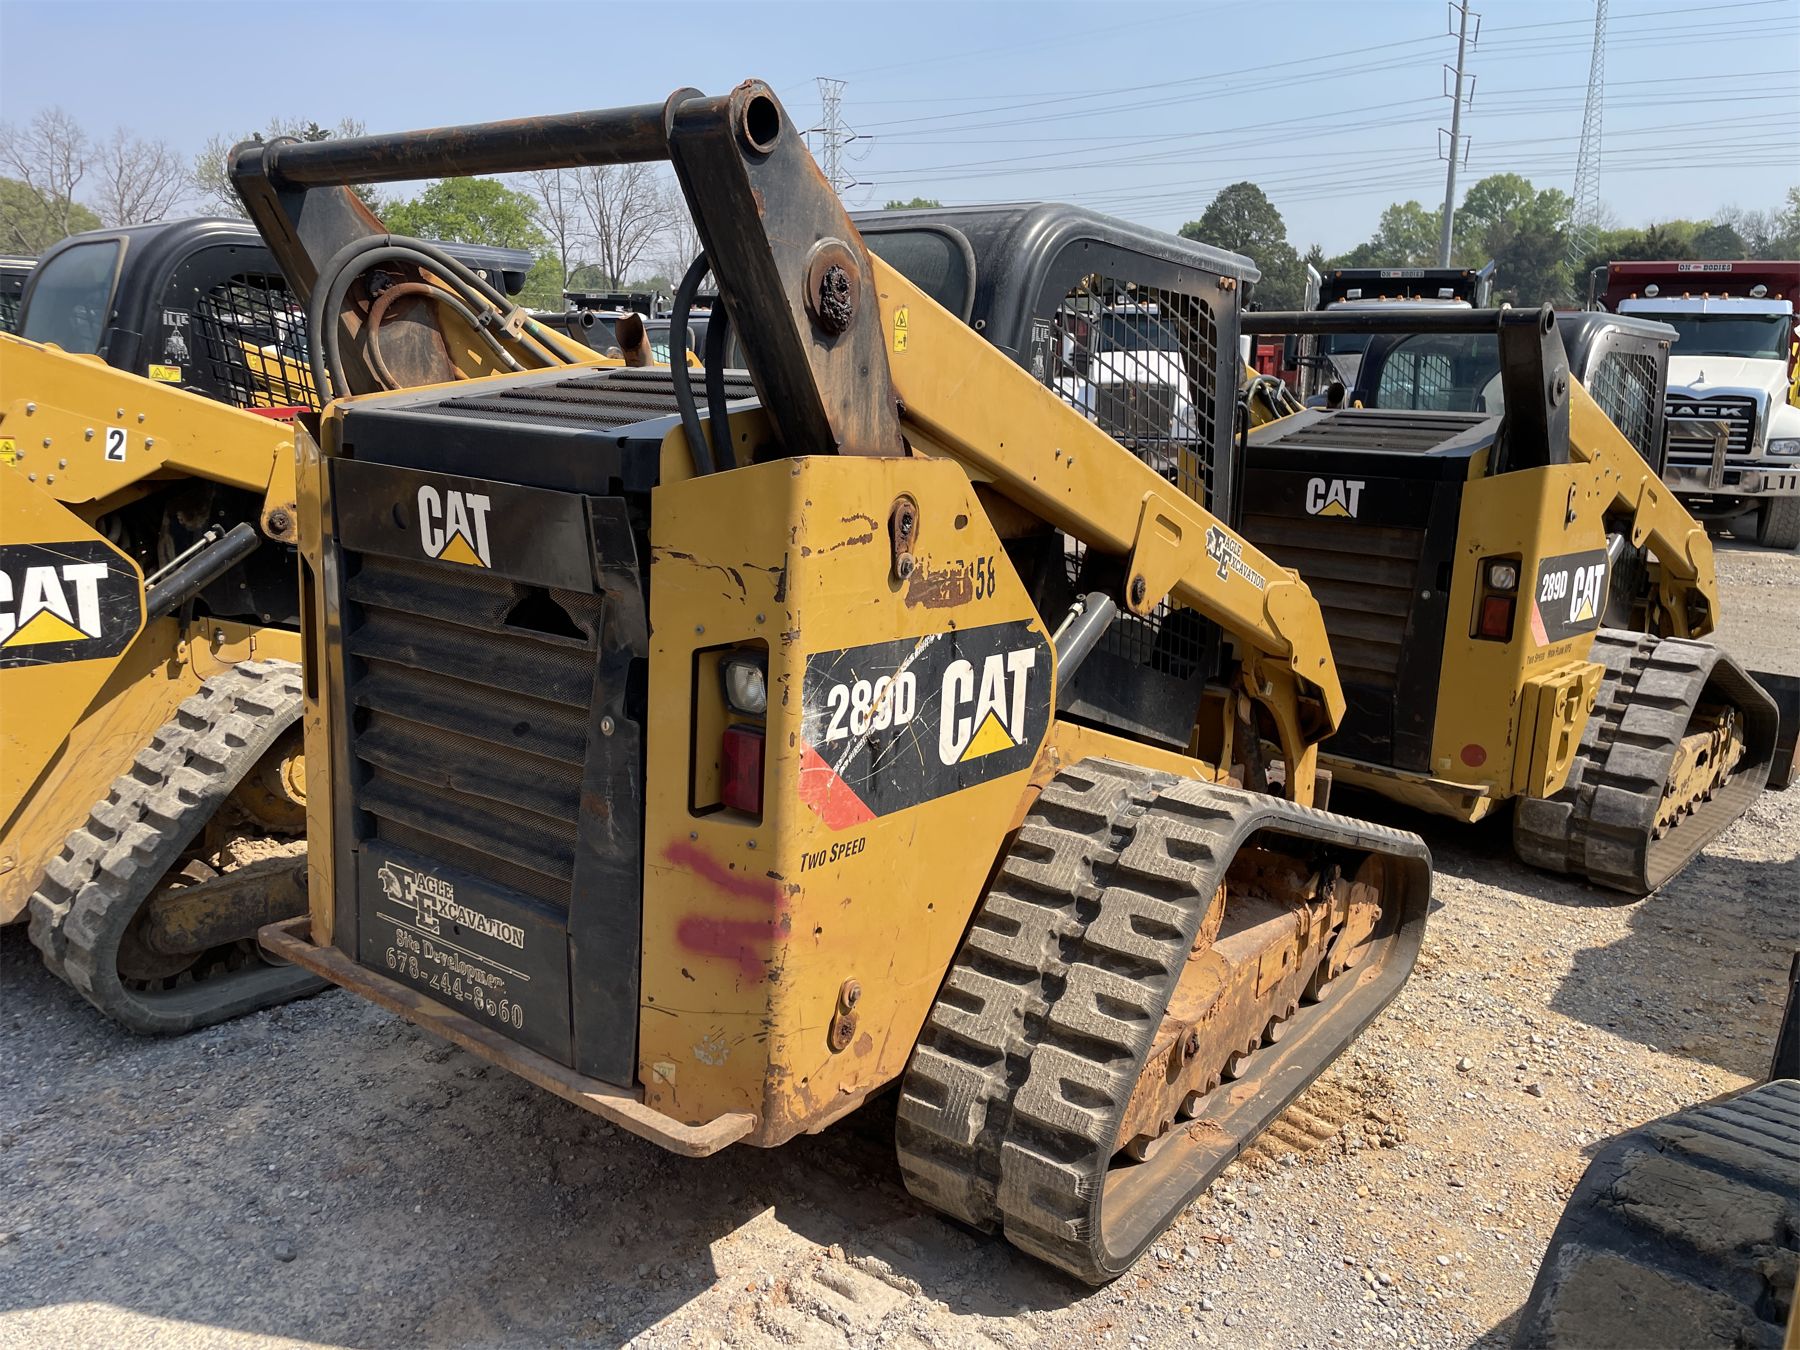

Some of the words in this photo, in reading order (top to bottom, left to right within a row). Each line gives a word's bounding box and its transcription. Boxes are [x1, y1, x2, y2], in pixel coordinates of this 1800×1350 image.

[108, 430, 124, 460] 2
[1305, 477, 1366, 518] CAT
[417, 485, 492, 568] CAT
[1208, 524, 1243, 563] EAGLE
[1540, 570, 1569, 603] 289D
[1570, 564, 1606, 622] CAT
[826, 671, 917, 746] 289D
[939, 648, 1036, 766] CAT
[384, 860, 454, 908] EAGLE
[416, 895, 525, 949] EXCAVATION
[395, 928, 420, 954] Site
[423, 939, 507, 990] Developmen
